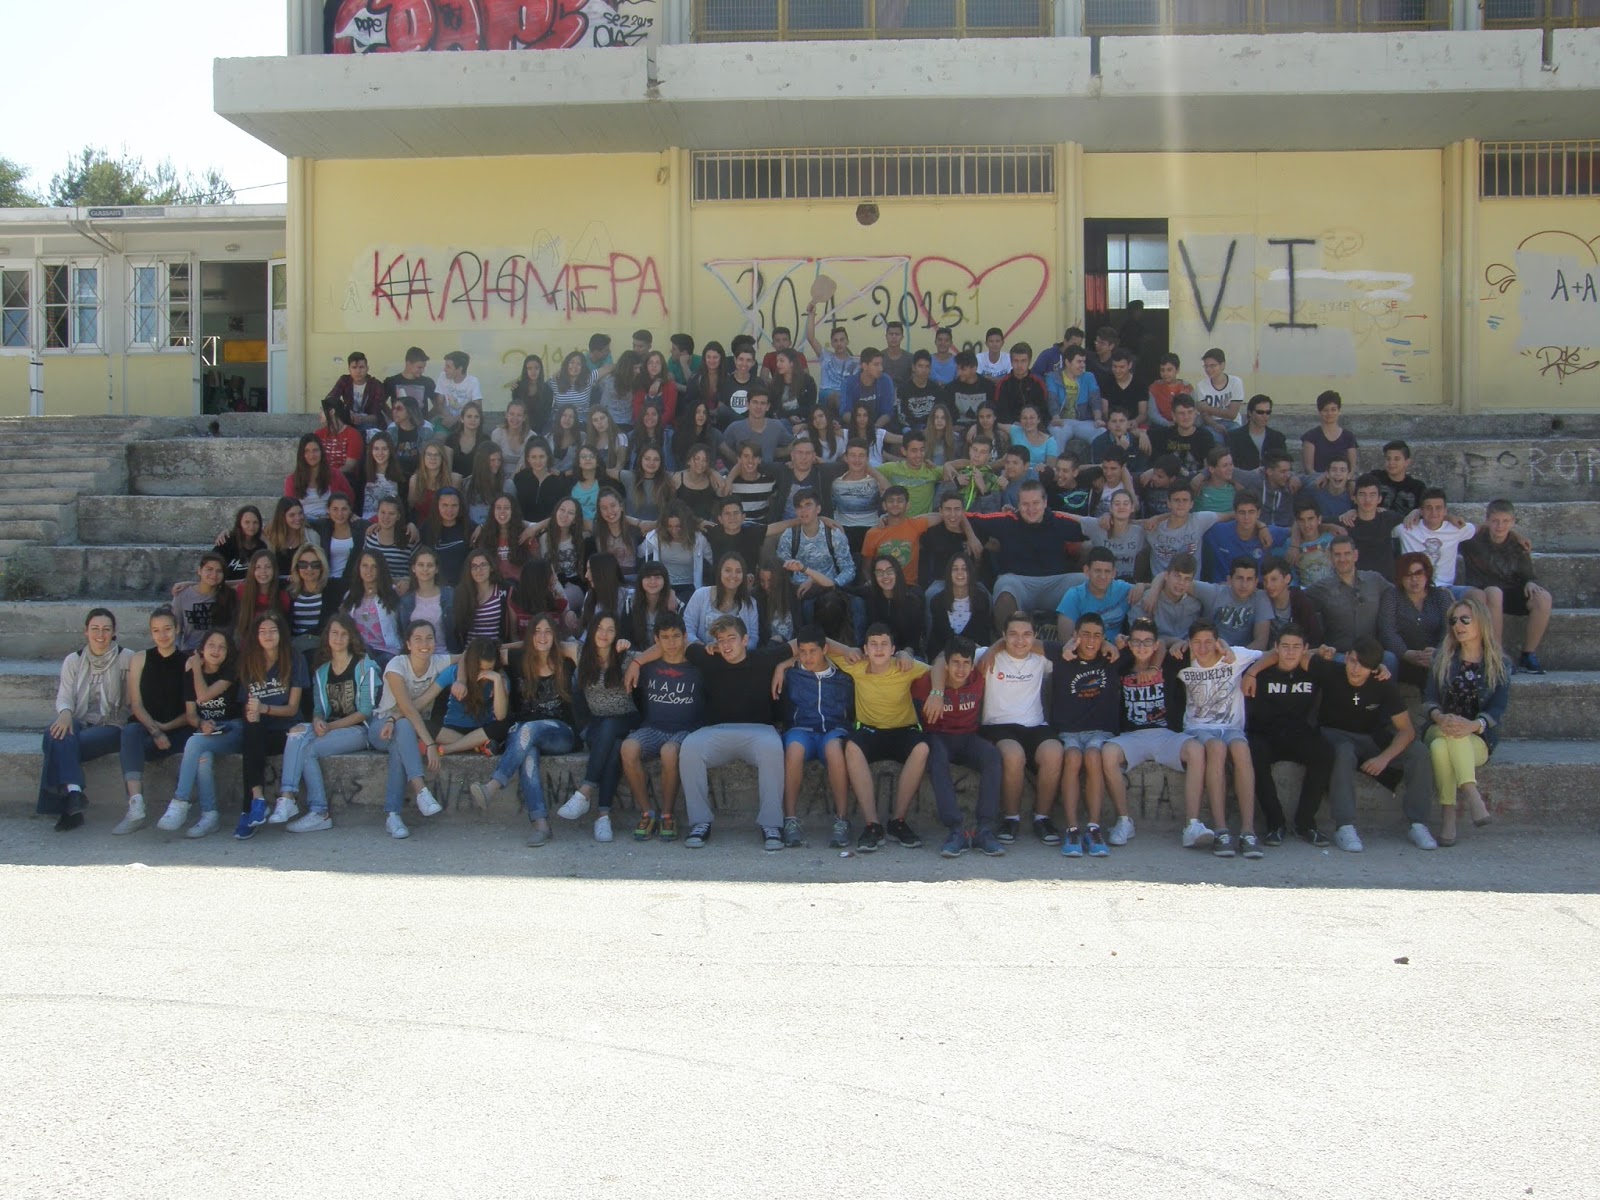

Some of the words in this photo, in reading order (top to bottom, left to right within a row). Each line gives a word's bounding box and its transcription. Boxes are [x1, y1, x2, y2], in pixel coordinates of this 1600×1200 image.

[1104, 540, 1124, 550] THIS
[1127, 541, 1137, 550] IS
[1183, 666, 1233, 681] BROOKLYN
[648, 679, 695, 693] MAUI
[1123, 683, 1165, 701] STYLE
[1268, 682, 1312, 693] NIKE
